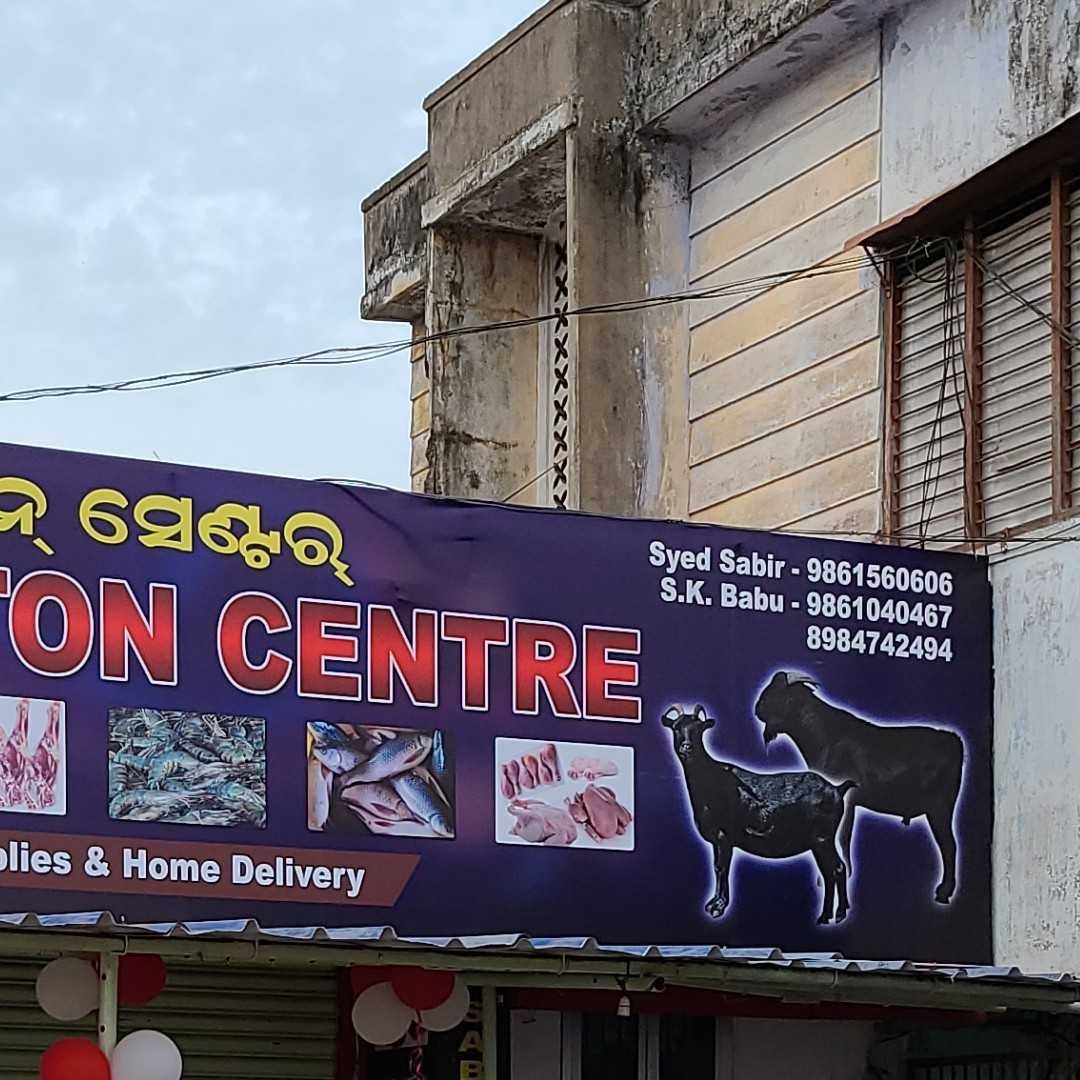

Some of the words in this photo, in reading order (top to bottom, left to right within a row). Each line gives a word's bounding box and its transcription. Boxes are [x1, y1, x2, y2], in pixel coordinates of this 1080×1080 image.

[649, 541, 711, 573] Syed
[719, 548, 785, 579] Sabir
[806, 557, 954, 596] 9861560606
[660, 577, 712, 606] S.K.
[720, 582, 784, 613] Babu
[806, 591, 953, 629] 9861040467
[217, 591, 642, 723] CENTRE
[806, 625, 953, 662] 8984742494
[83, 846, 111, 877] &
[123, 848, 221, 884] Home
[231, 855, 366, 898] Delivery
